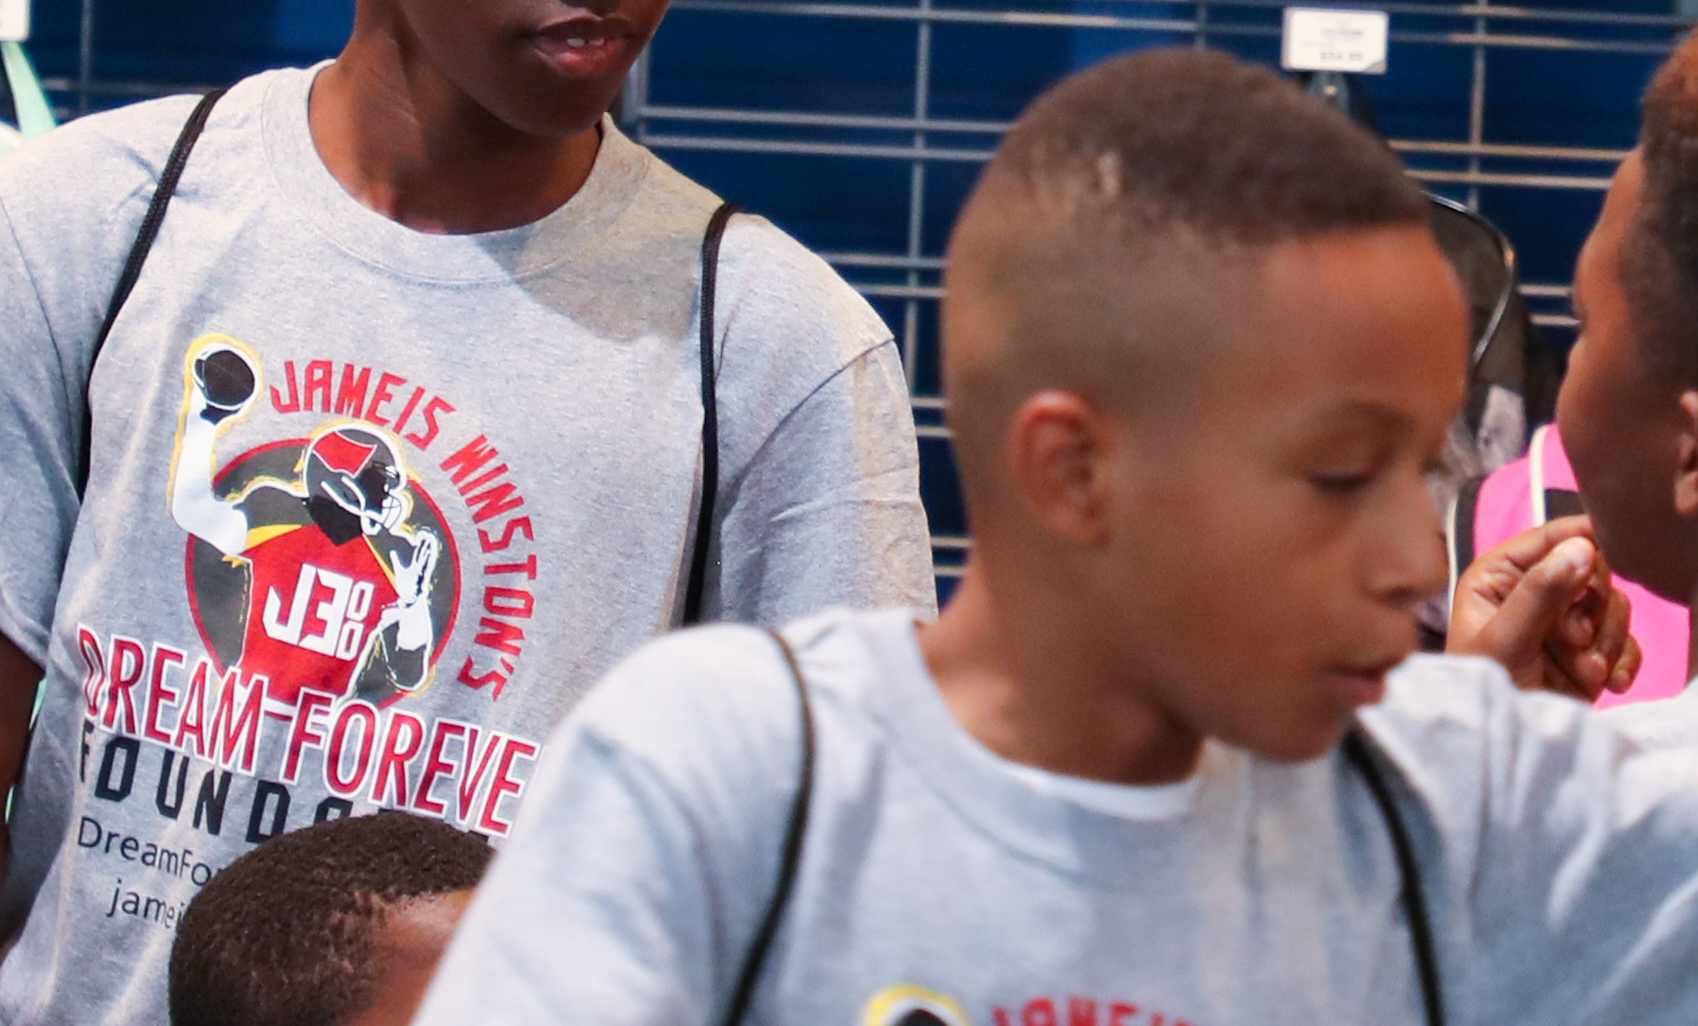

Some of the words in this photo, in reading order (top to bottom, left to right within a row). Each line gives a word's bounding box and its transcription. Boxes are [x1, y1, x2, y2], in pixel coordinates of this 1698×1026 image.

[269, 360, 457, 451] JAMEIS
[438, 433, 537, 702] WINSTON'S
[77, 622, 269, 777] DREAM
[77, 816, 224, 887] DreamFo
